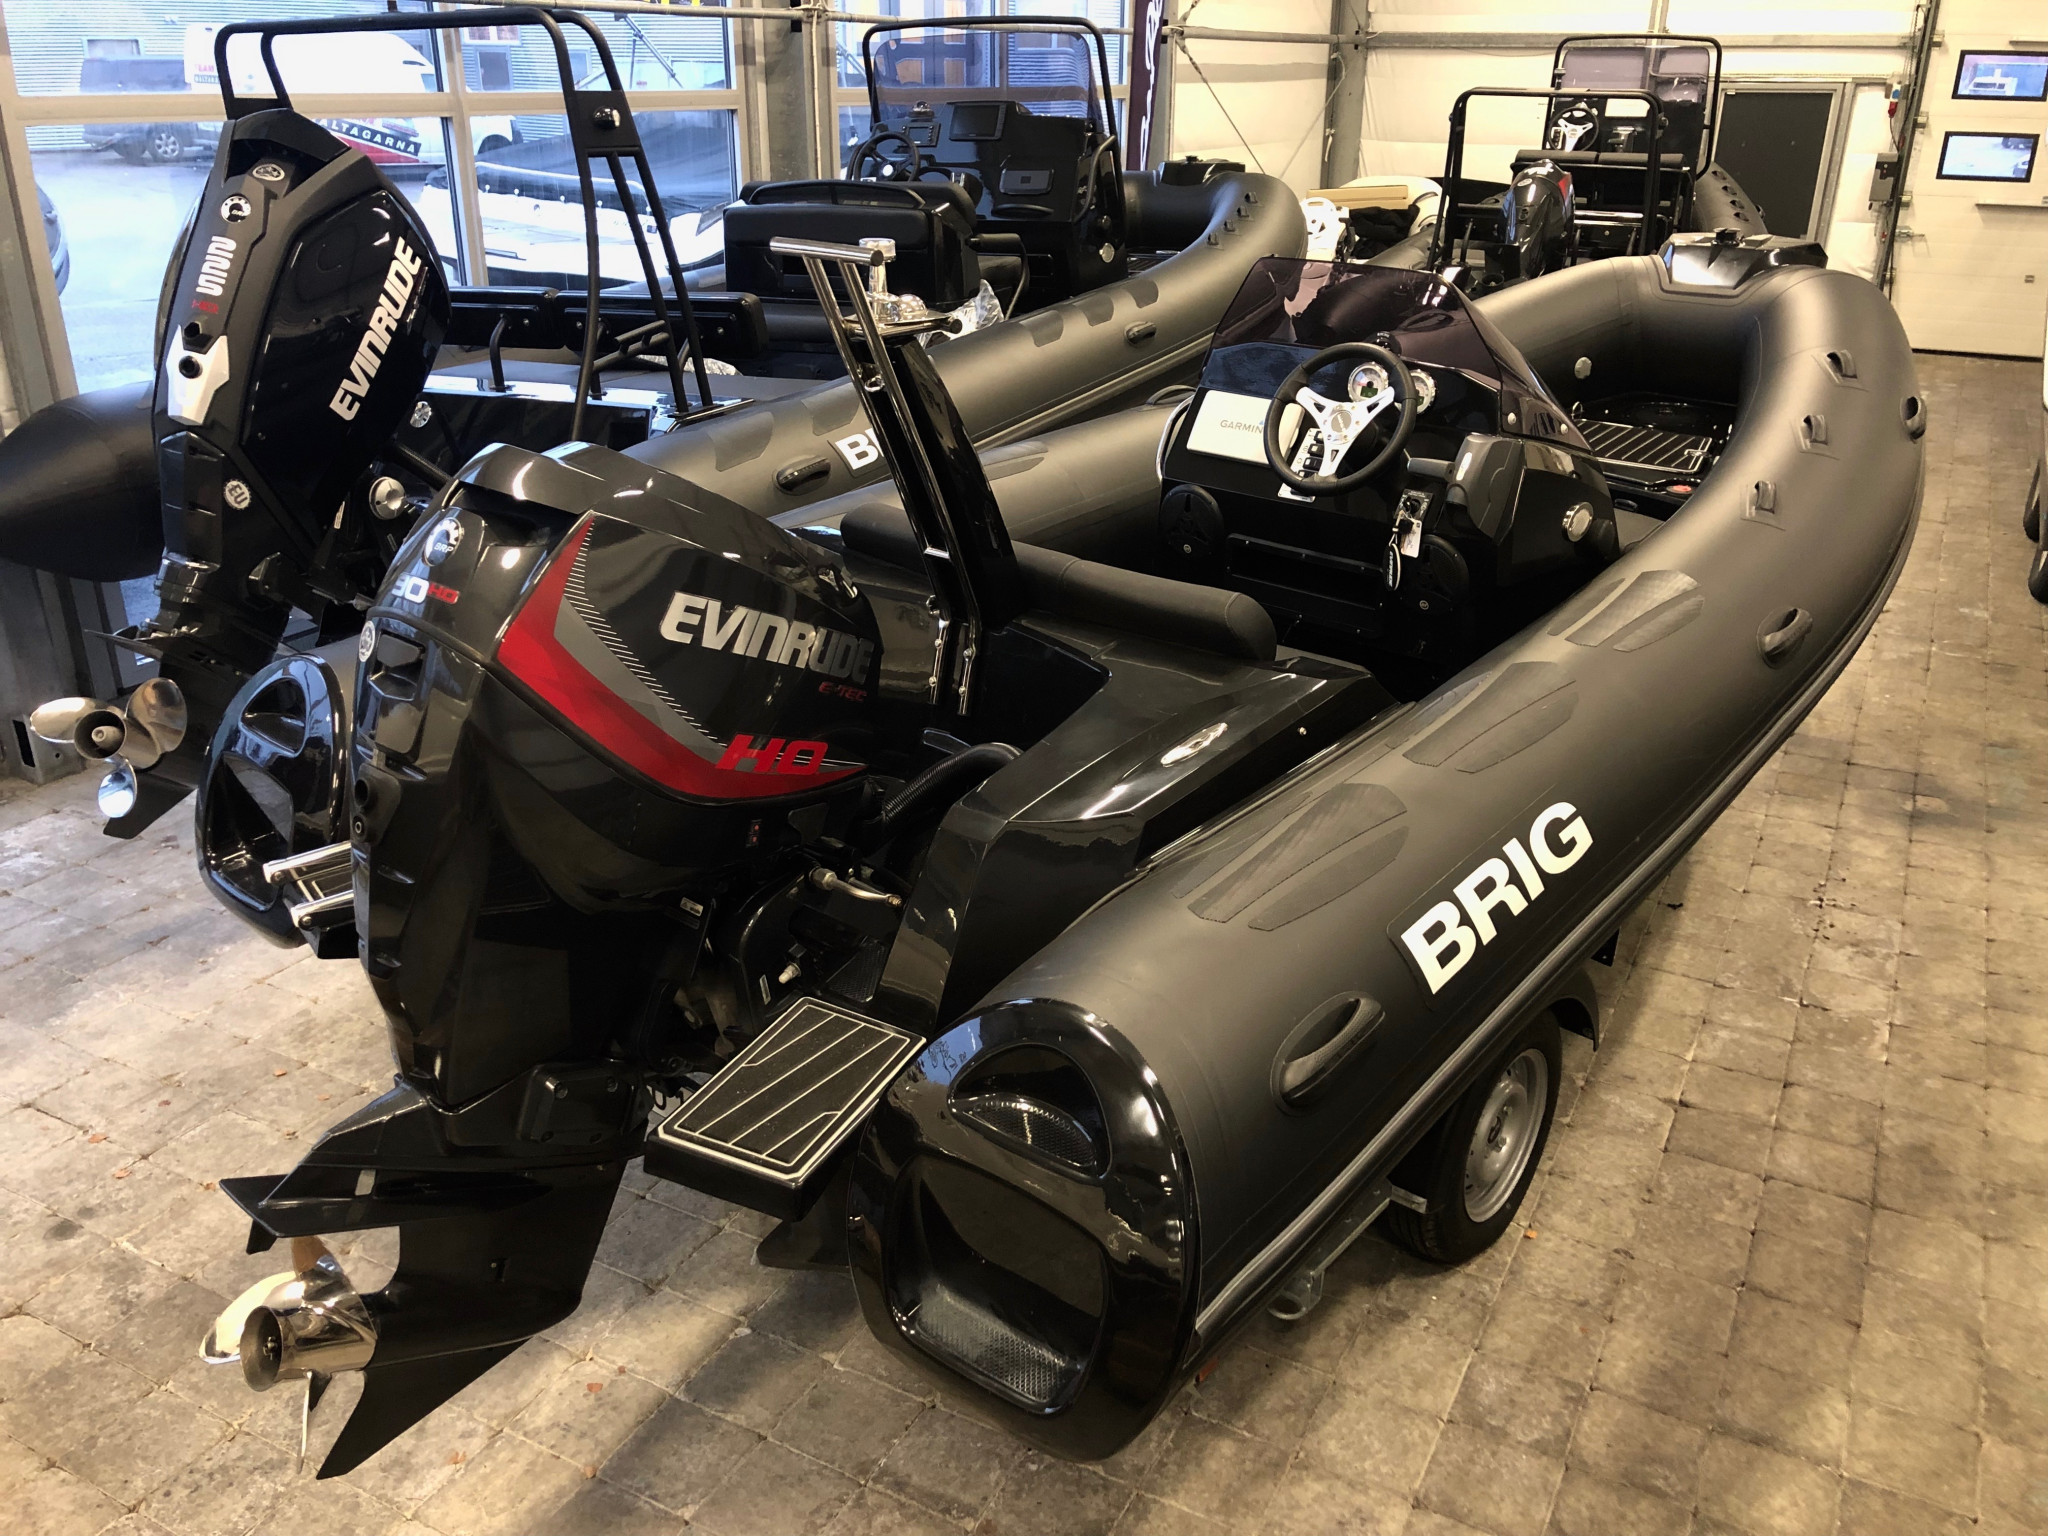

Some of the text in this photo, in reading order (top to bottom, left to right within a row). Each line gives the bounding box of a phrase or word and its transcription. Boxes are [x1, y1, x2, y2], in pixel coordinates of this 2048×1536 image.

[317, 119, 416, 154] ALTAGARNA
[329, 236, 422, 421] EVINRUDE
[1219, 418, 1264, 434] GARMIN
[433, 541, 454, 553] BRP
[659, 590, 875, 686] EVINRUDE
[715, 743, 829, 776] HO
[1400, 801, 1594, 995] BRIG
